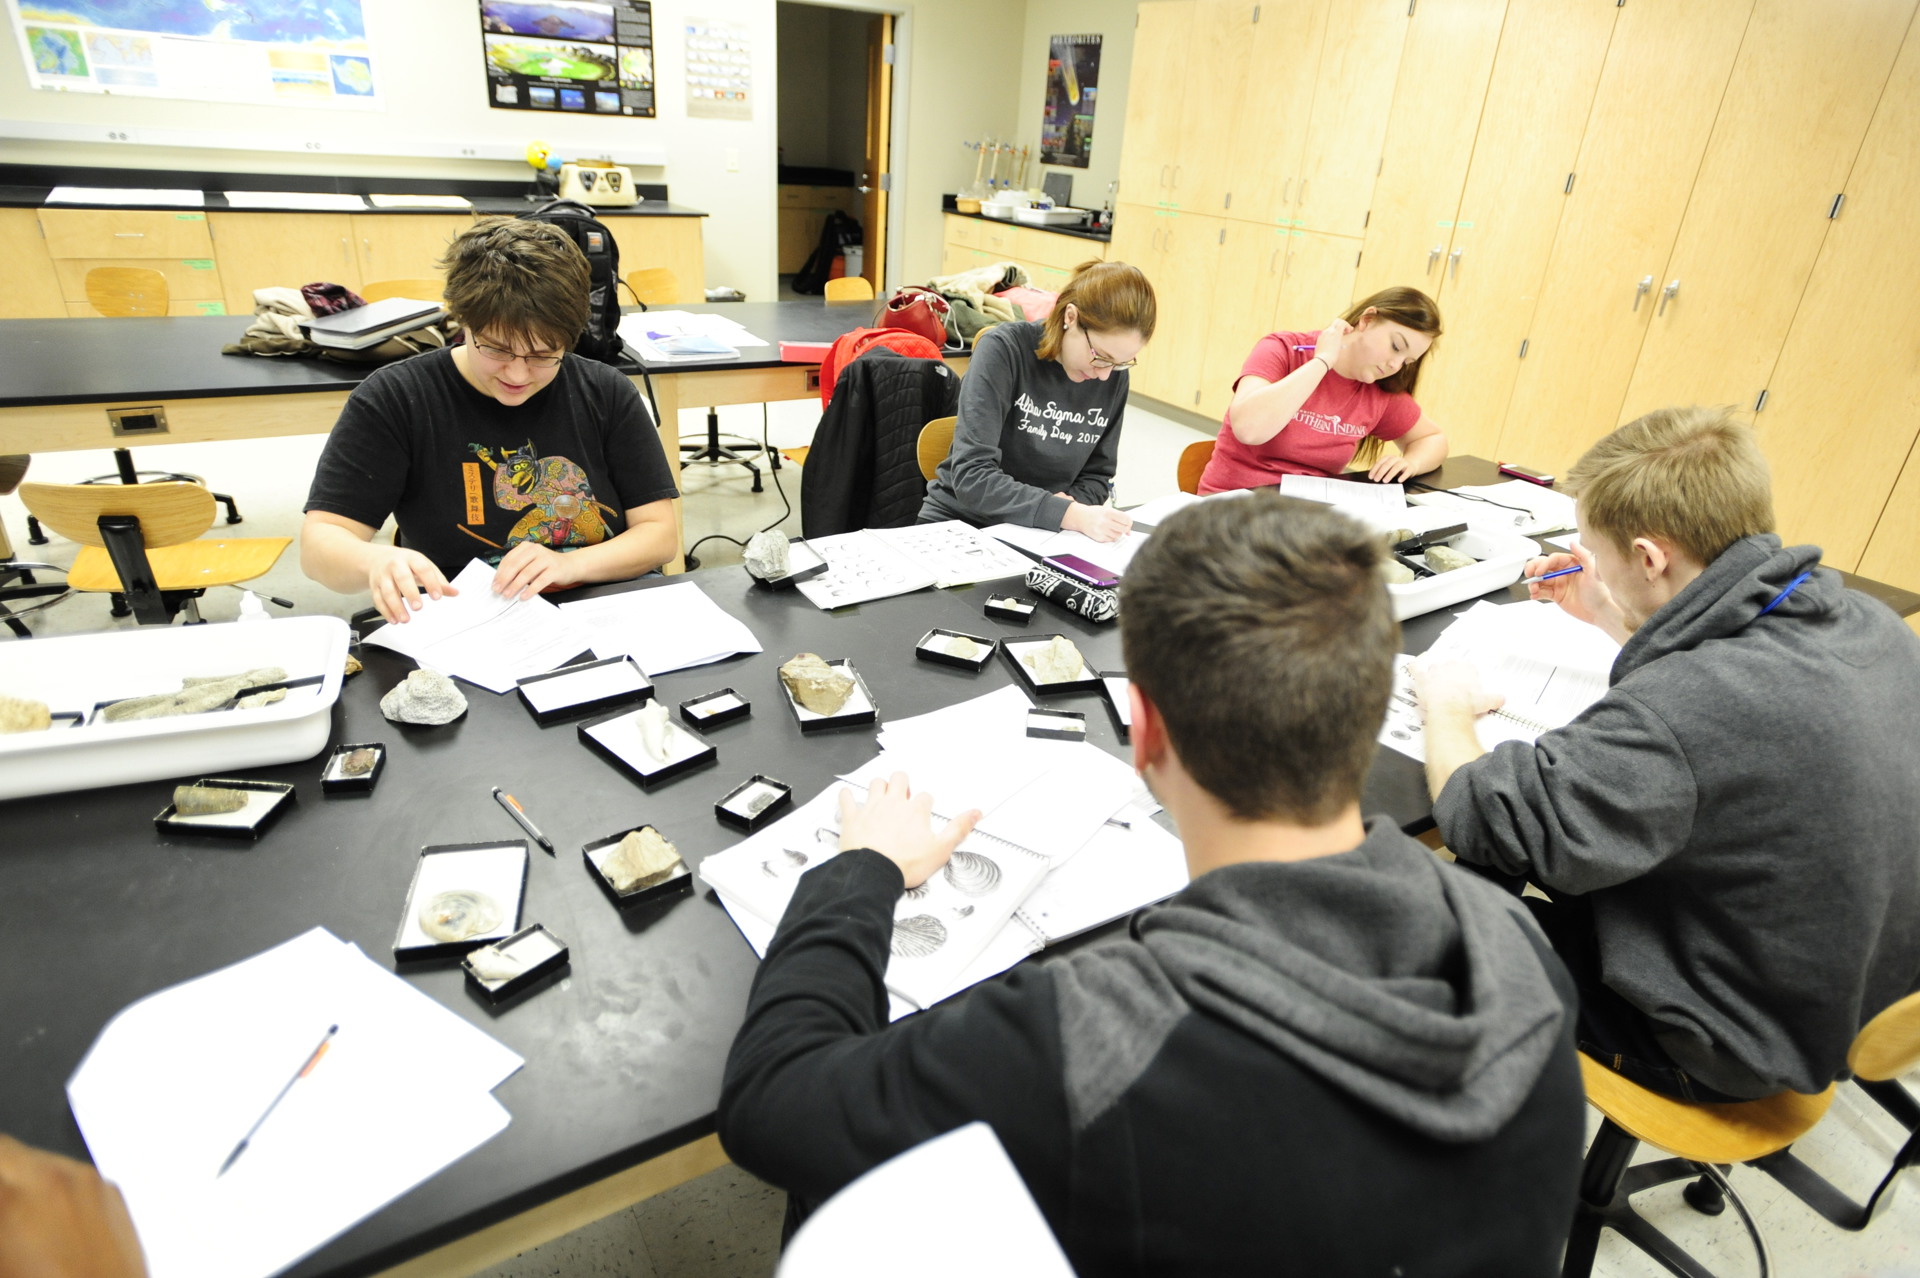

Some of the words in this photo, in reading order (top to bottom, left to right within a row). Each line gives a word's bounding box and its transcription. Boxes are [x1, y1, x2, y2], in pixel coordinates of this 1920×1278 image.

[1014, 392, 1041, 419] Alpha
[1042, 401, 1085, 426] Sigma
[1017, 419, 1048, 440] Family
[1050, 426, 1073, 445] Day
[1076, 432, 1101, 443] 2017
